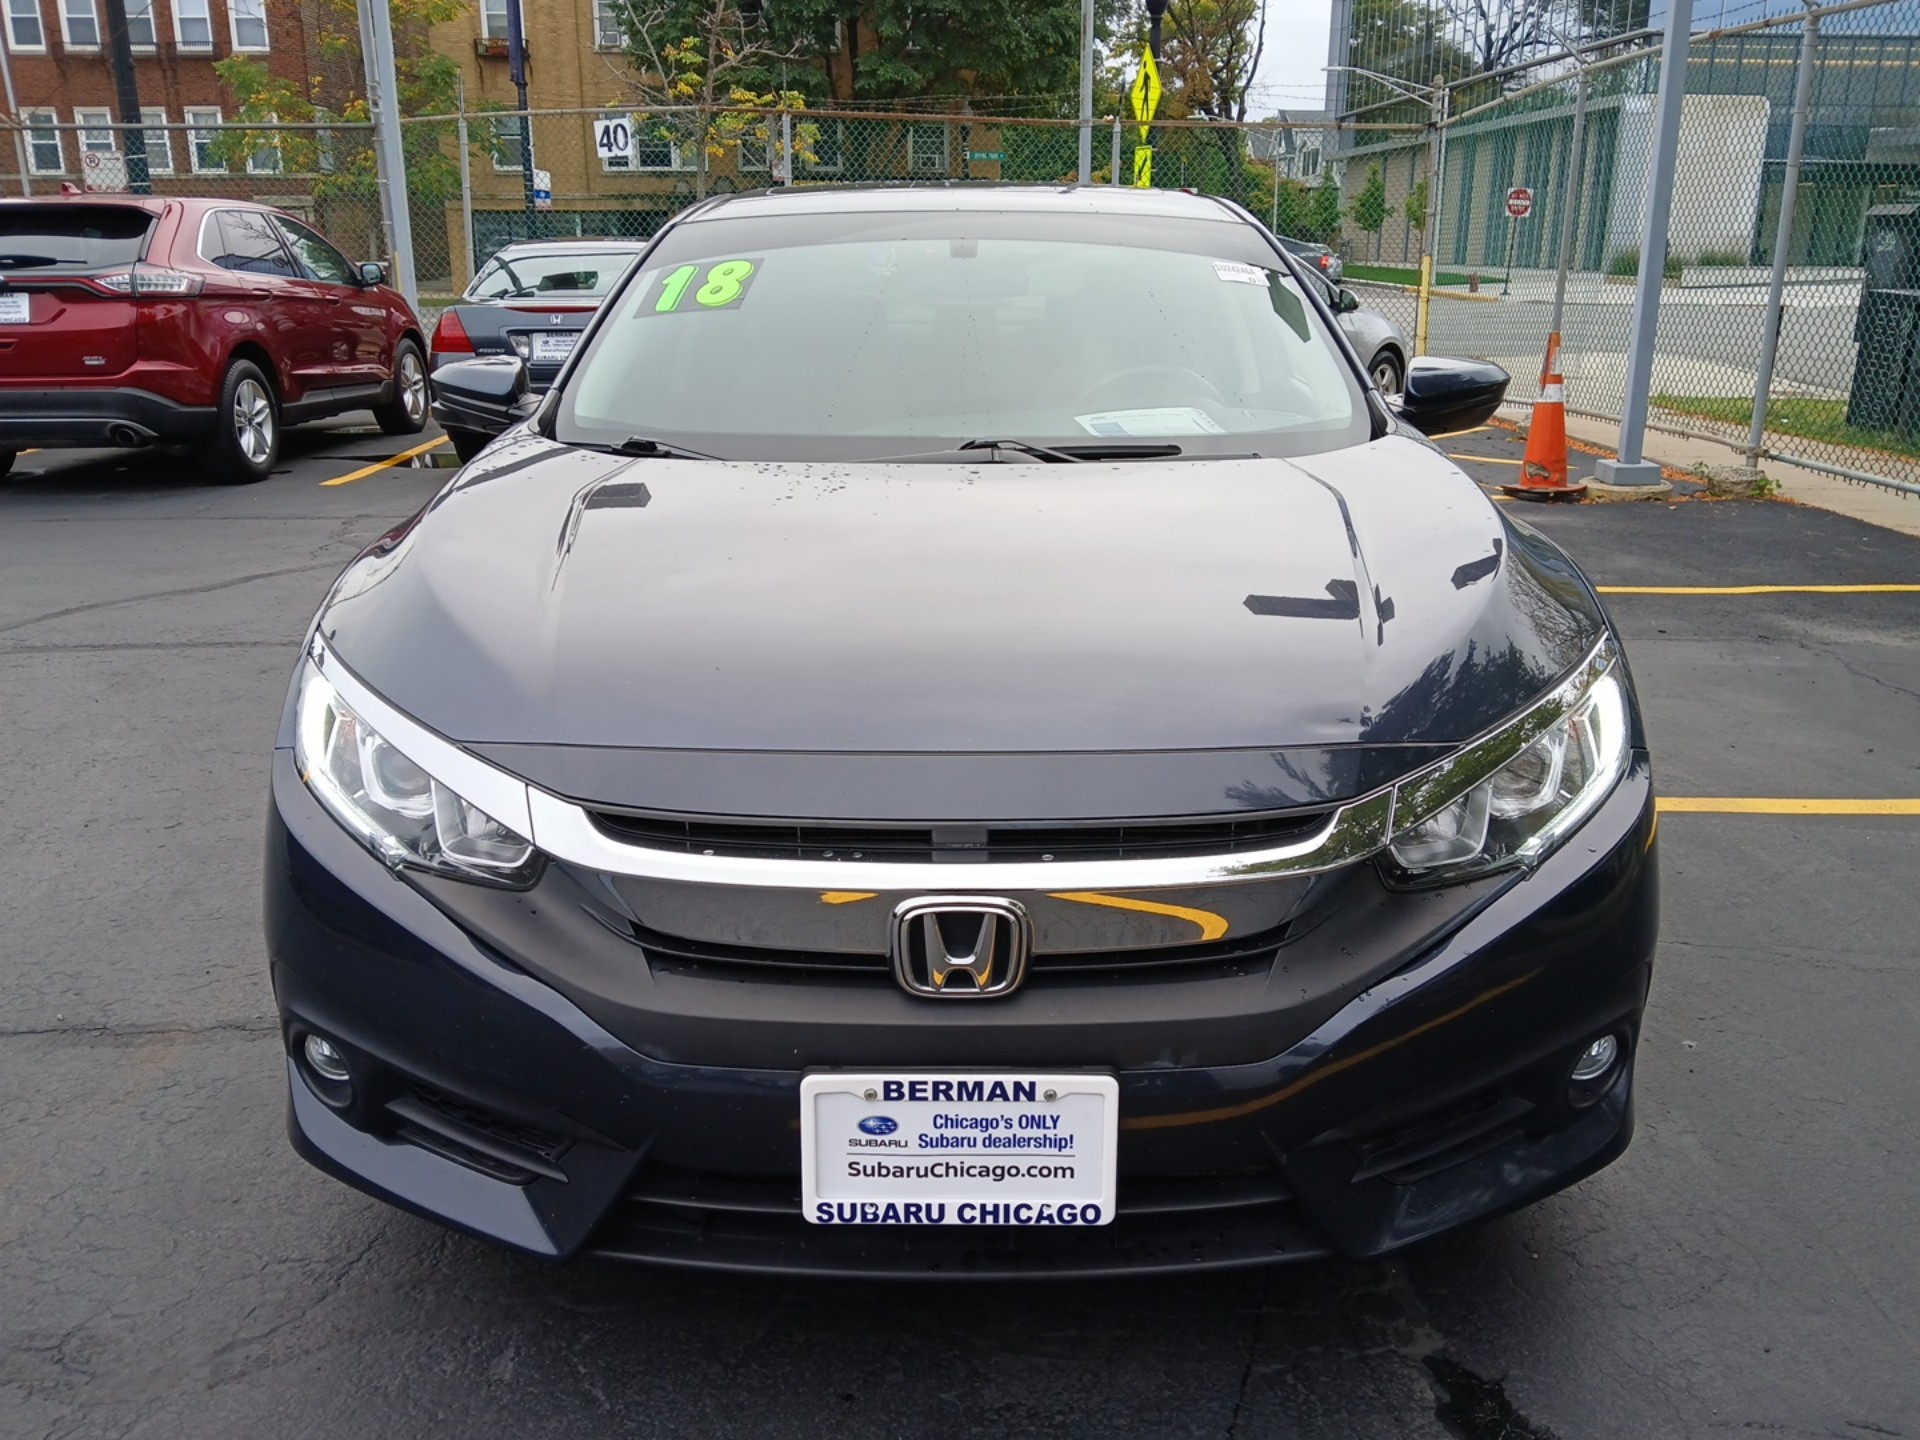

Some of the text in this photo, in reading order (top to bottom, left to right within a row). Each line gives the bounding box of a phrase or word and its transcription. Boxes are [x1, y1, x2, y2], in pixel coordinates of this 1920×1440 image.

[599, 123, 628, 152] 40
[655, 260, 754, 313] 18
[883, 1081, 1036, 1102] BERMAN
[1018, 1114, 1061, 1130] ONLY
[848, 1139, 908, 1148] SUBARU
[918, 1133, 1074, 1152] Subaru dealership!
[848, 1161, 1074, 1182] SubaruChicago.com
[816, 1202, 1102, 1225] SUBARU CHICAGO
